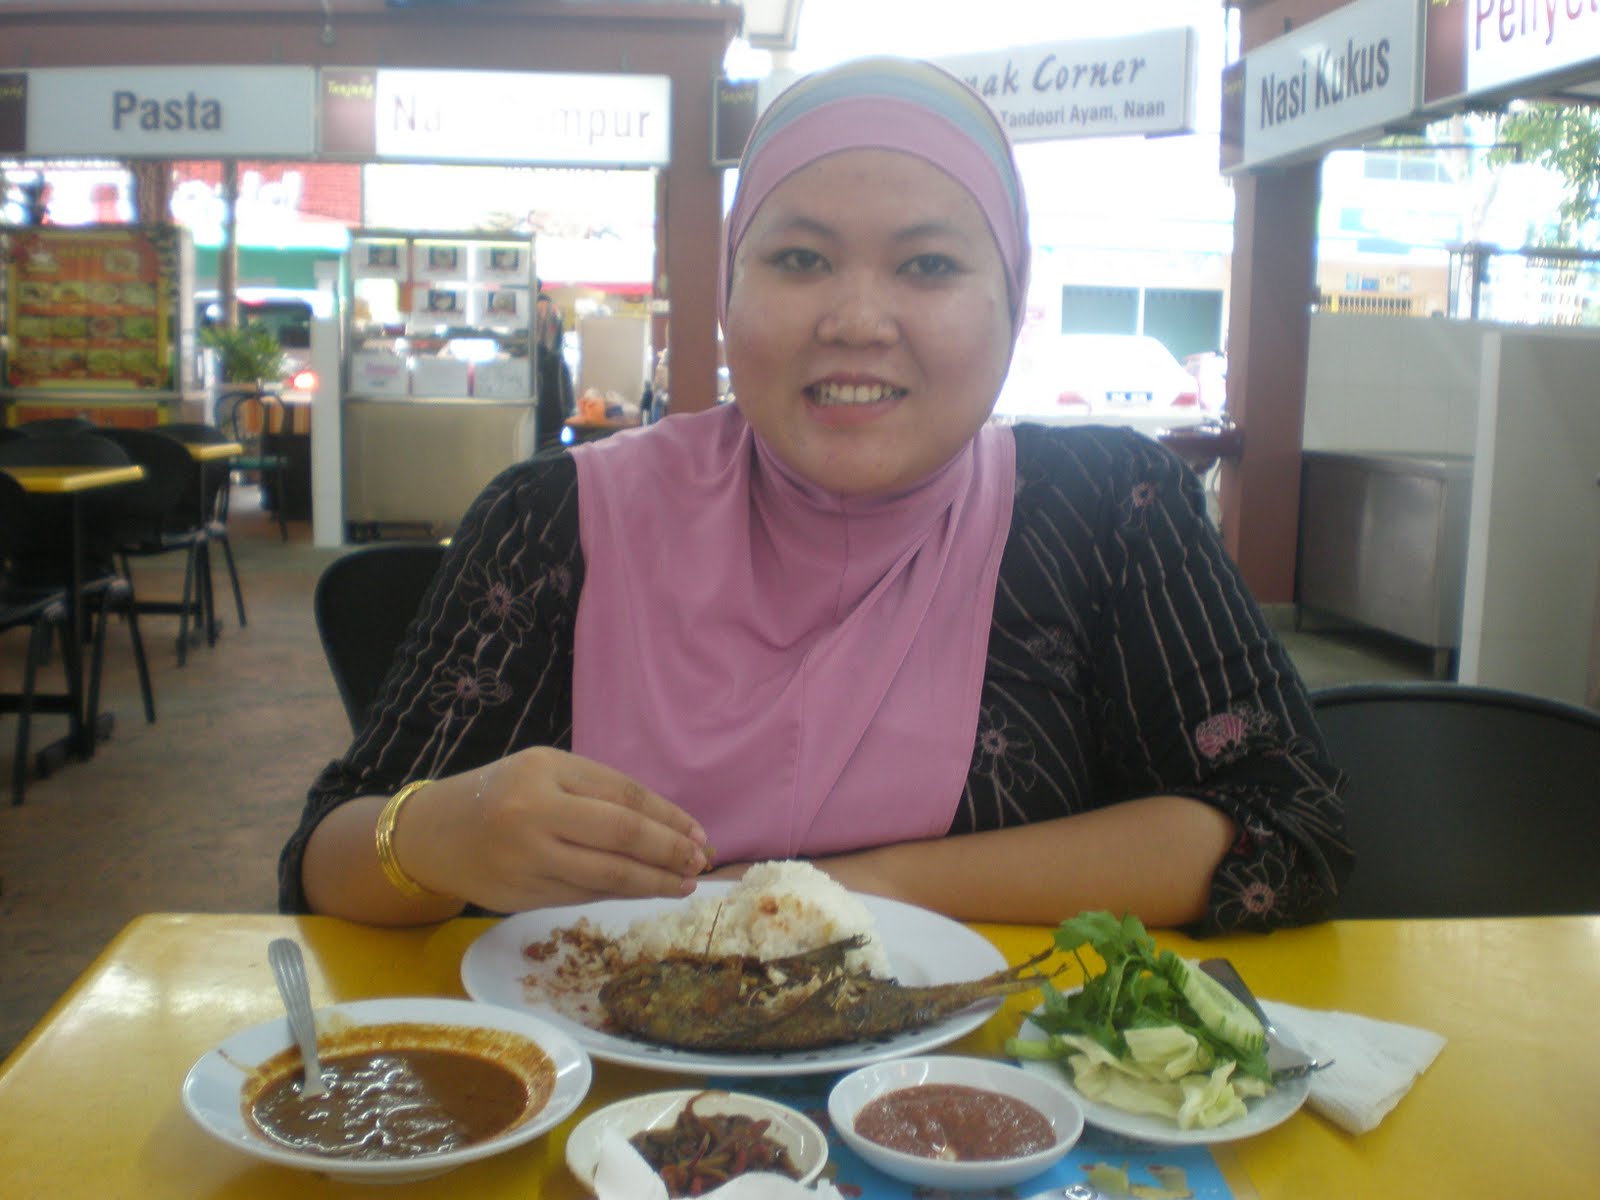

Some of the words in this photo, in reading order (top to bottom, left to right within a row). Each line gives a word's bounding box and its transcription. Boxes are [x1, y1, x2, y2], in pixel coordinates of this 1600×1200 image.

[1031, 52, 1147, 92] Corner
[1260, 57, 1308, 130] Nasi
[1315, 36, 1392, 110] Kukus
[112, 89, 221, 130] Pasta
[1000, 104, 1066, 128] Tandoori
[1069, 103, 1119, 127] Ayam,
[1123, 99, 1166, 119] Naan
